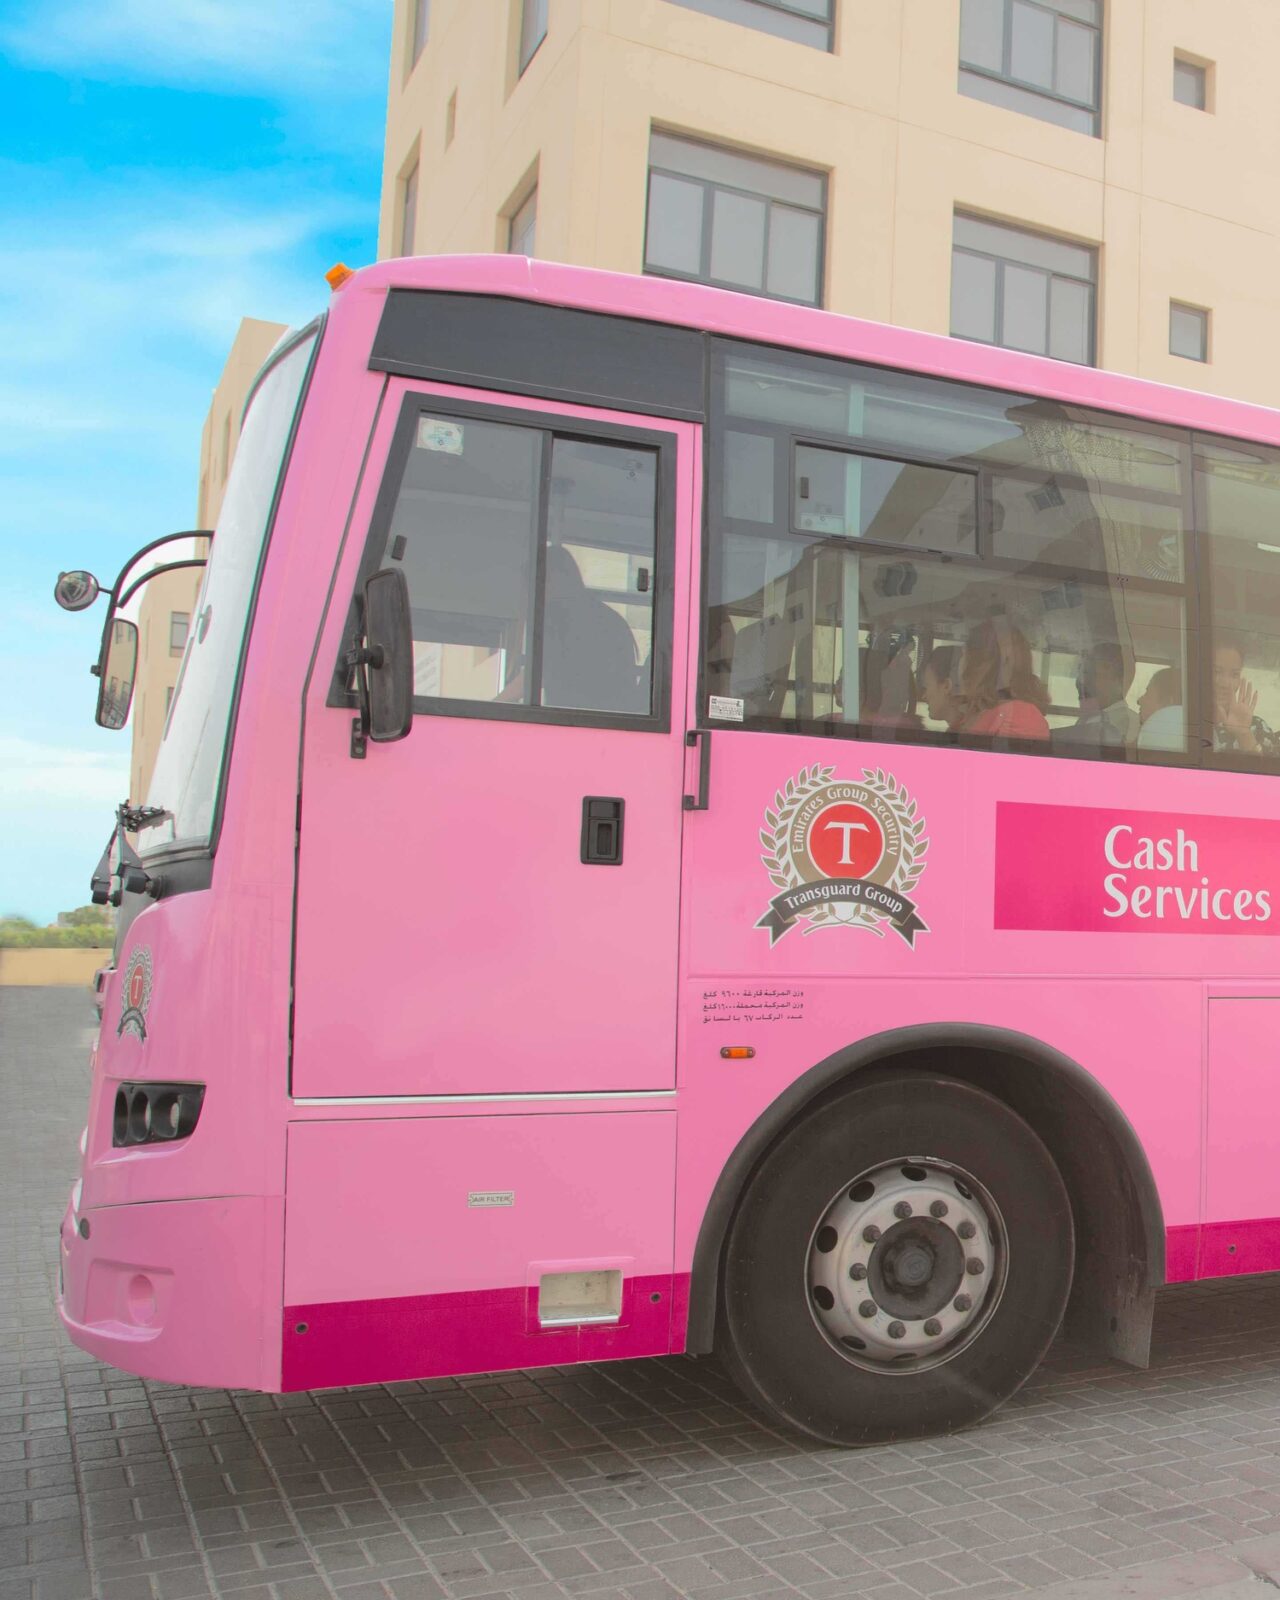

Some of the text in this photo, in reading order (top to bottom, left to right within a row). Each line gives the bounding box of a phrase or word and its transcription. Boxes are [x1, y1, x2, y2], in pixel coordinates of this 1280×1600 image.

[824, 821, 870, 865] T
[827, 787, 869, 802] Group
[870, 797, 901, 856] Security
[1104, 825, 1198, 872] Cash
[783, 884, 903, 913] Transguard Group
[1103, 873, 1271, 921] Services
